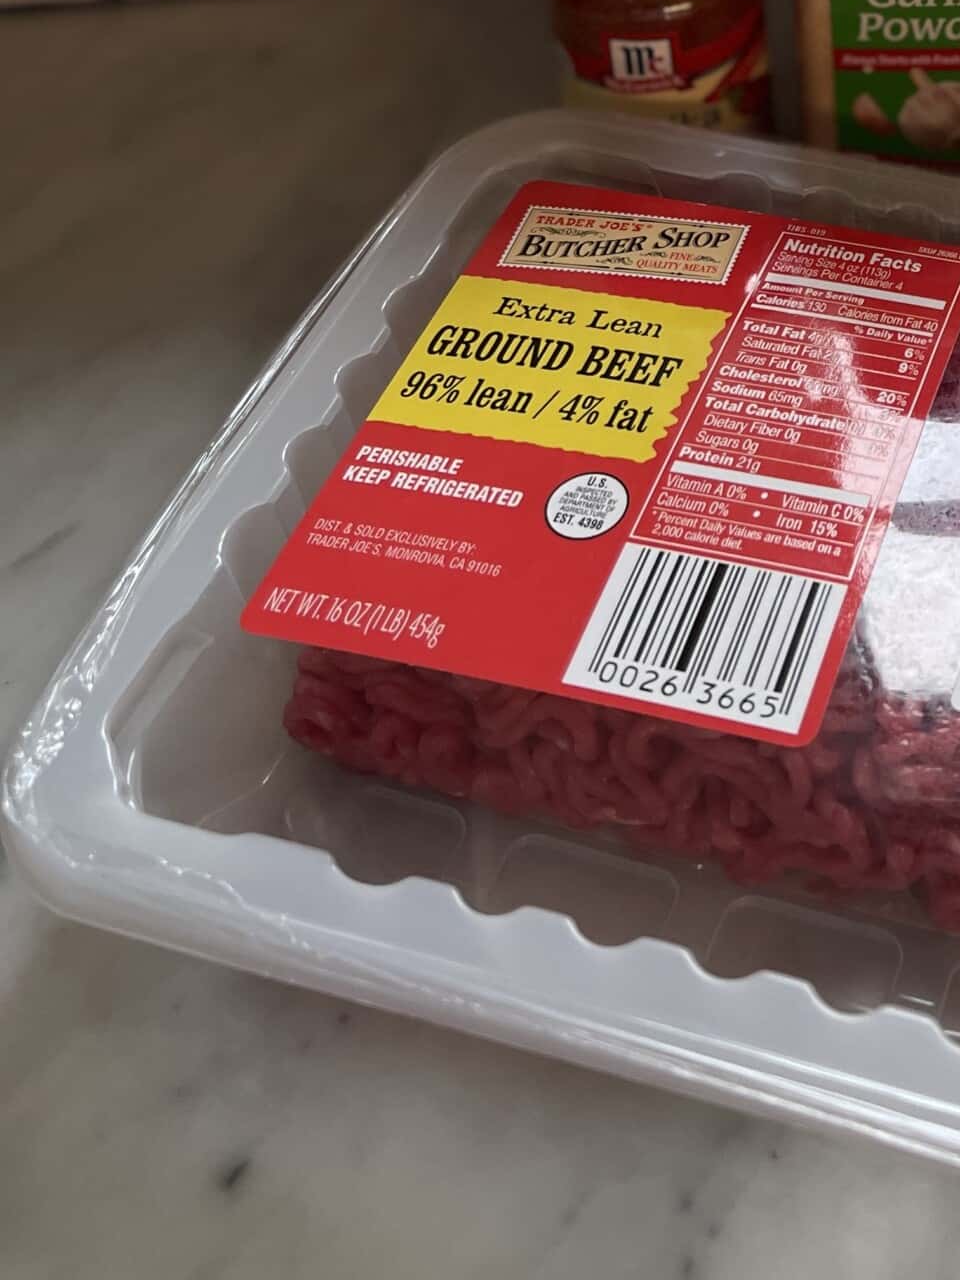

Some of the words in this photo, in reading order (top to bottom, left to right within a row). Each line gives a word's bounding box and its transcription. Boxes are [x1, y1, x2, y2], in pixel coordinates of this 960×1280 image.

[535, 215, 596, 229] TRADER
[599, 220, 644, 232] JOE'S
[517, 234, 647, 259] BUTCHER
[653, 227, 730, 249] SHOP
[636, 259, 681, 271] QUALITY
[683, 262, 718, 274] MEATS
[669, 251, 692, 261] FINE
[777, 252, 813, 268] Serving
[816, 257, 836, 269] Size
[784, 238, 866, 264] Nutrition
[869, 252, 922, 273] Facts
[772, 261, 818, 278] Servings
[821, 269, 841, 280] Per
[843, 272, 894, 289] Container
[762, 283, 803, 294] Amount
[825, 291, 865, 305] Serving
[493, 296, 577, 326] Extra
[586, 309, 663, 340] Lean
[755, 294, 805, 310] Calories
[837, 305, 879, 322] Calories
[742, 321, 780, 336] Total
[782, 328, 805, 340] Fat
[866, 326, 897, 342] Daily
[426, 325, 572, 373] GROUND
[577, 352, 684, 389] BEEF
[741, 337, 801, 355] Saturated
[734, 351, 766, 365] Trans
[768, 357, 790, 369] Fat
[719, 365, 802, 388] Cholesterol
[399, 370, 468, 406] 96%
[463, 383, 533, 416] lean
[532, 389, 560, 419] /
[558, 393, 609, 426] 4%
[608, 399, 655, 435] fat
[711, 381, 765, 399] Sodium
[768, 390, 804, 407] 65mg
[704, 396, 744, 413] Total
[746, 404, 845, 431] Carbohydrate
[704, 414, 747, 432] Dietary
[750, 424, 782, 438] Fiber
[696, 431, 740, 450] Sugars
[355, 445, 463, 476] PERISHABLE
[679, 446, 734, 466] Protein
[735, 456, 761, 473] 21g
[342, 465, 390, 484] KEEP
[390, 472, 524, 508] REFRIGERATED
[587, 476, 607, 488] U.S.
[666, 474, 712, 495] Vitamin
[656, 492, 706, 513] Calcium
[781, 494, 829, 515] Vitamin
[553, 512, 575, 526] EST.
[776, 514, 802, 530] Iron
[810, 519, 838, 537] 15%
[354, 524, 385, 540] SOLD
[385, 528, 458, 553] EXCLUSIVELY
[658, 511, 699, 528] Percent
[699, 518, 727, 533] Daily
[728, 523, 762, 540] Values
[783, 534, 815, 552] based
[684, 530, 720, 545] calorie
[306, 532, 350, 550] TRADER
[449, 556, 466, 570] CA
[466, 560, 502, 578] 91016
[263, 586, 300, 613] NET
[300, 592, 329, 619] WT.
[326, 597, 344, 623] 16
[343, 601, 372, 627] OZ
[409, 612, 446, 648] 454g
[599, 661, 678, 697] 0026
[696, 681, 780, 718] 3665
